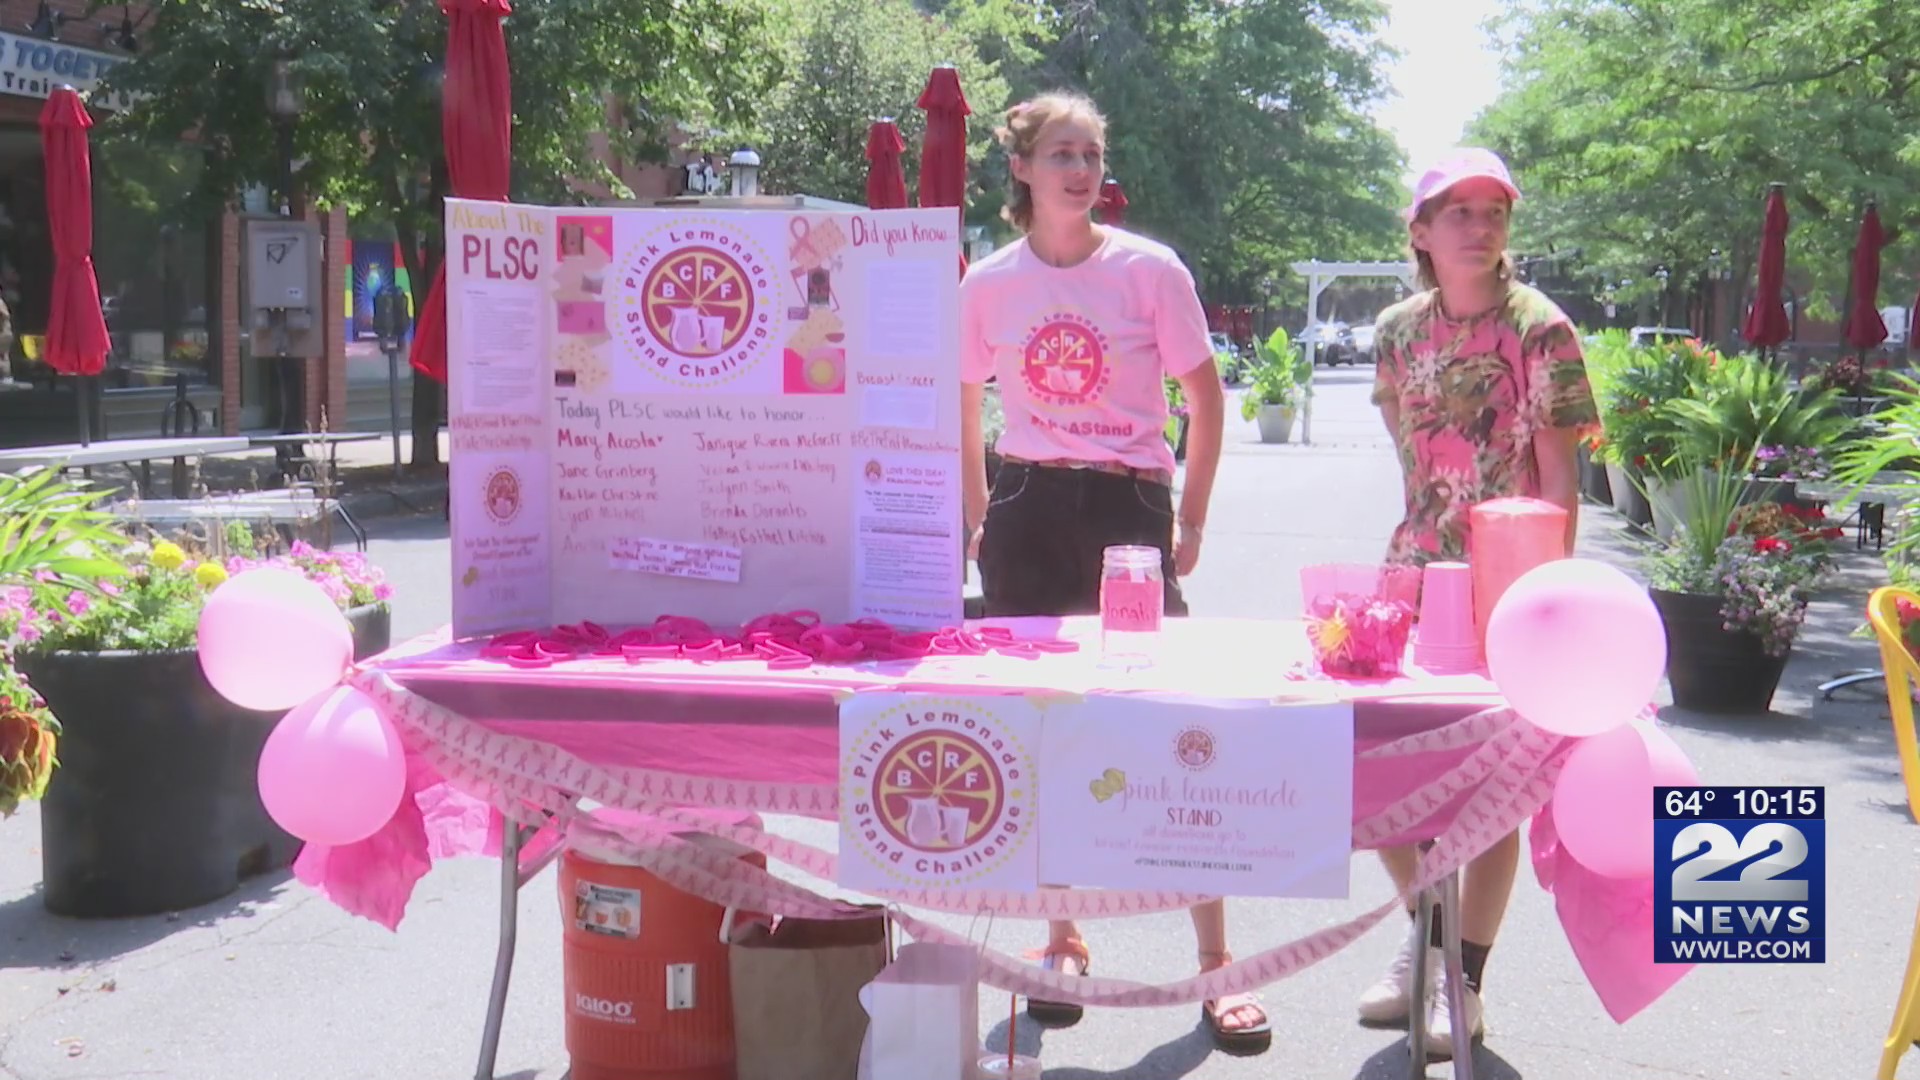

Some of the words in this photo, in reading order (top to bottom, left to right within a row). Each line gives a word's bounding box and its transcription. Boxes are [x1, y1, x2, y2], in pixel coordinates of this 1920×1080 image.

[453, 207, 507, 230] About
[517, 212, 545, 235] The
[851, 216, 879, 247] Did
[882, 227, 907, 257] you
[462, 234, 539, 280] PLSC
[625, 243, 660, 289] Pink
[670, 230, 767, 289] Lemonade
[627, 311, 669, 369] Stand
[679, 313, 768, 378] Challenge
[555, 397, 600, 429] Today
[609, 400, 656, 421] PLSC
[663, 405, 701, 421] would
[707, 405, 733, 421] like
[740, 406, 757, 421] to
[557, 428, 602, 461] Mary
[607, 431, 656, 450] Acosta
[556, 463, 589, 479] Jane
[595, 464, 658, 487] Grinberg
[753, 479, 792, 496] Smith
[853, 728, 894, 778] Pink
[905, 711, 1019, 780] Lemonade
[1121, 776, 1172, 813] pink
[1183, 776, 1297, 808] lemonade
[1167, 807, 1222, 827] STAND
[855, 803, 903, 863] Stand
[915, 806, 1020, 874] Challenge
